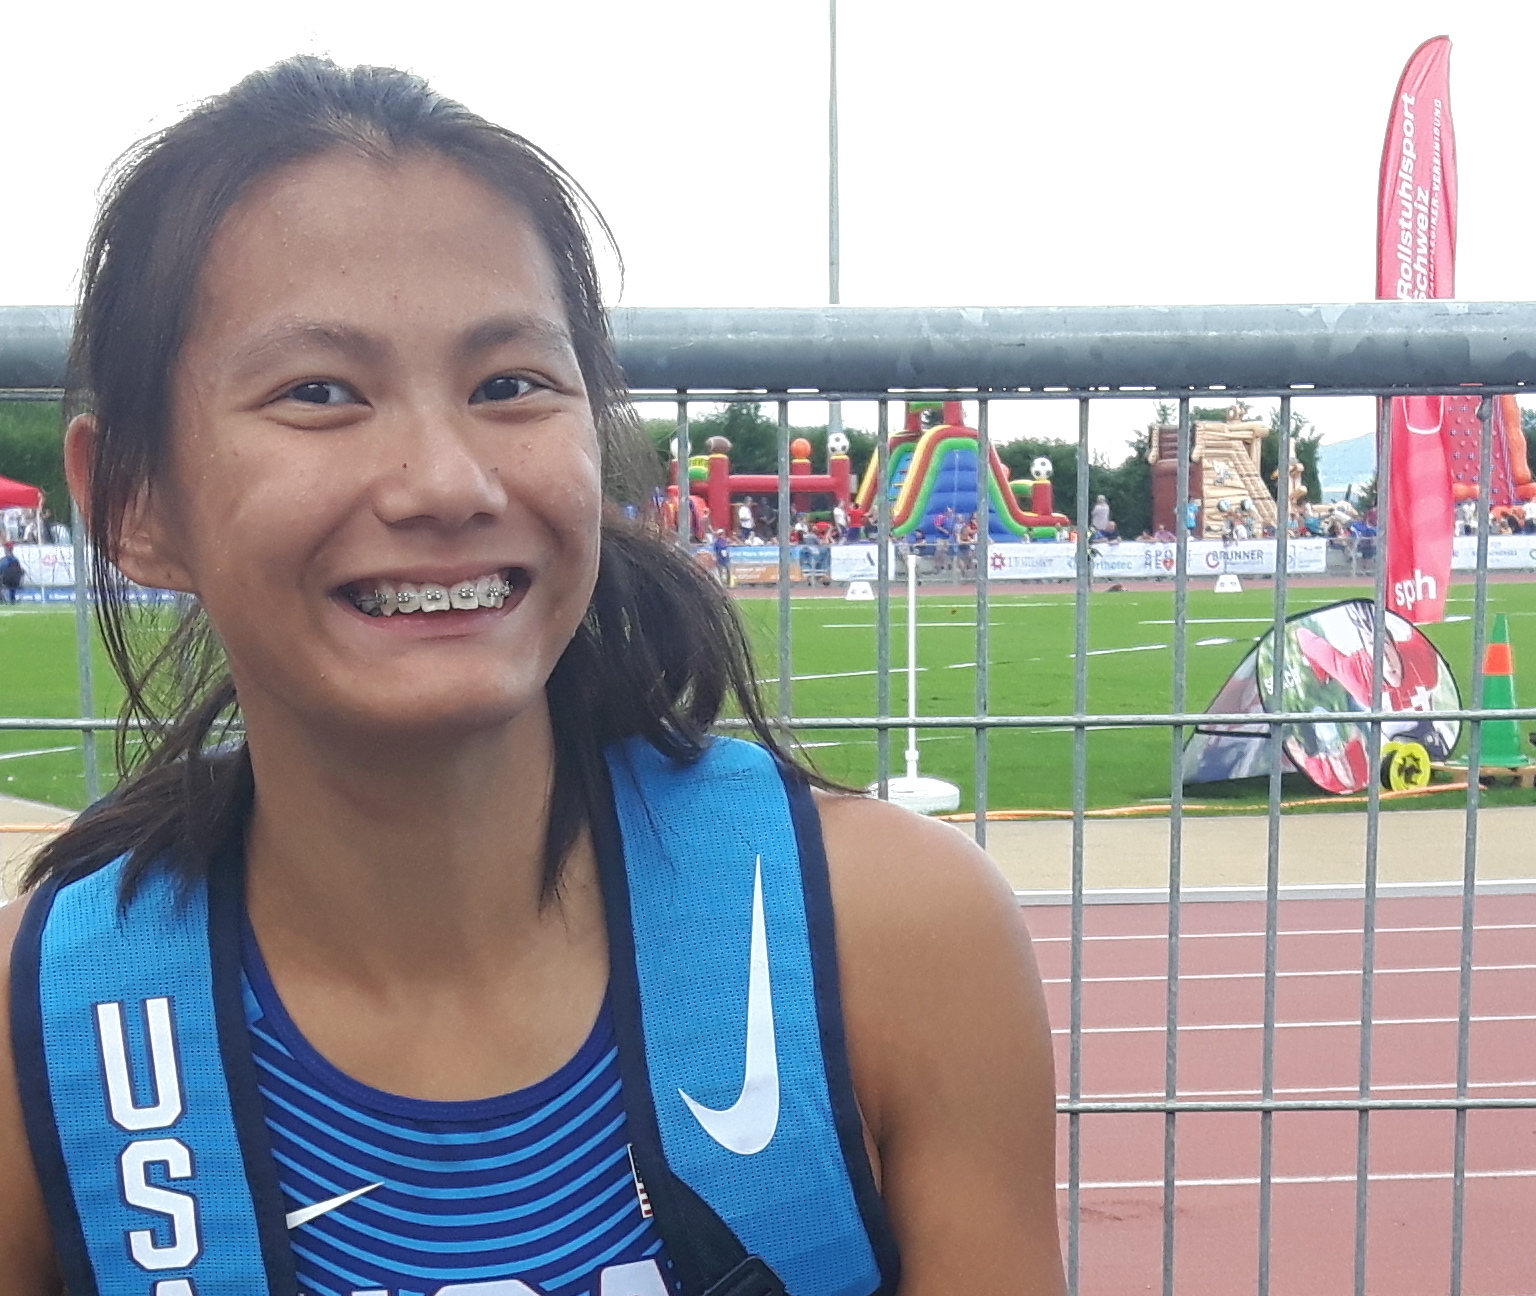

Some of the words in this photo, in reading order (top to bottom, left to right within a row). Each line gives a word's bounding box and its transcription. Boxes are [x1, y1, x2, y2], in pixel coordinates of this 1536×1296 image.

[1396, 92, 1416, 300] Rollstuhlsport
[1414, 186, 1430, 300] Schweiz
[1212, 549, 1264, 561] BRUNNER
[1395, 569, 1436, 610] sph
